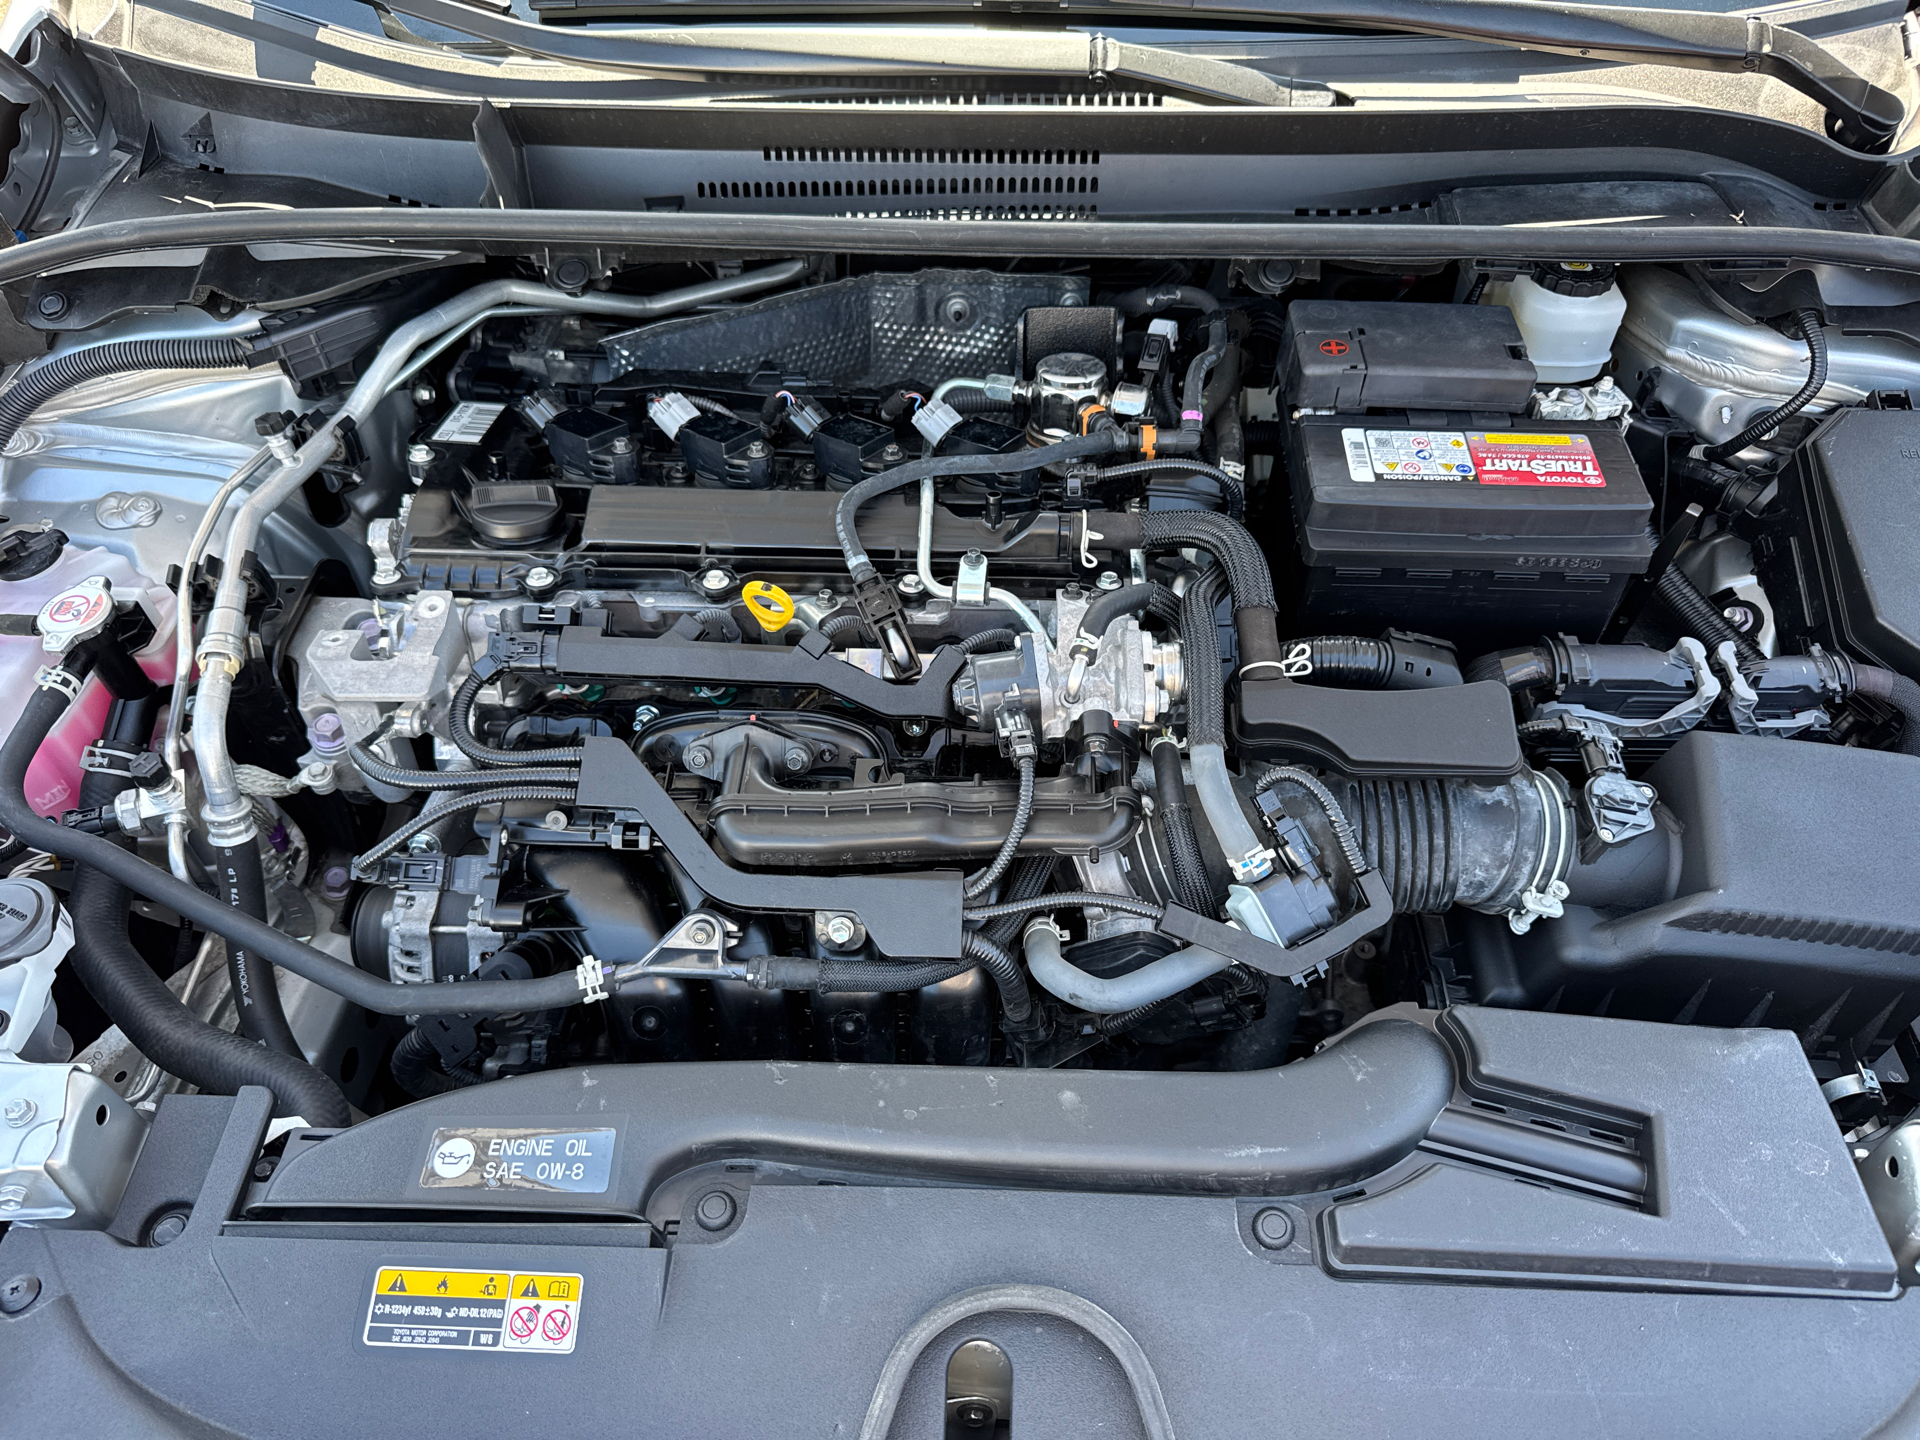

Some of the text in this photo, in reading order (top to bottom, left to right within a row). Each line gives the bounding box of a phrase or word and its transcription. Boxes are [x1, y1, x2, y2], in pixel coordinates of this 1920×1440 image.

[1383, 473, 1462, 482] DANGER/POISON
[1536, 475, 1584, 483] TOYOTA
[236, 950, 250, 995] YOKOHAMA
[488, 1139, 592, 1157] ENGINE OIL
[483, 1162, 585, 1180] SAE 0W-8
[384, 1304, 411, 1316] R-1234yf
[413, 1305, 442, 1318] 450±30g
[393, 1328, 458, 1338] TOYOTA MOTOR CORPORATION
